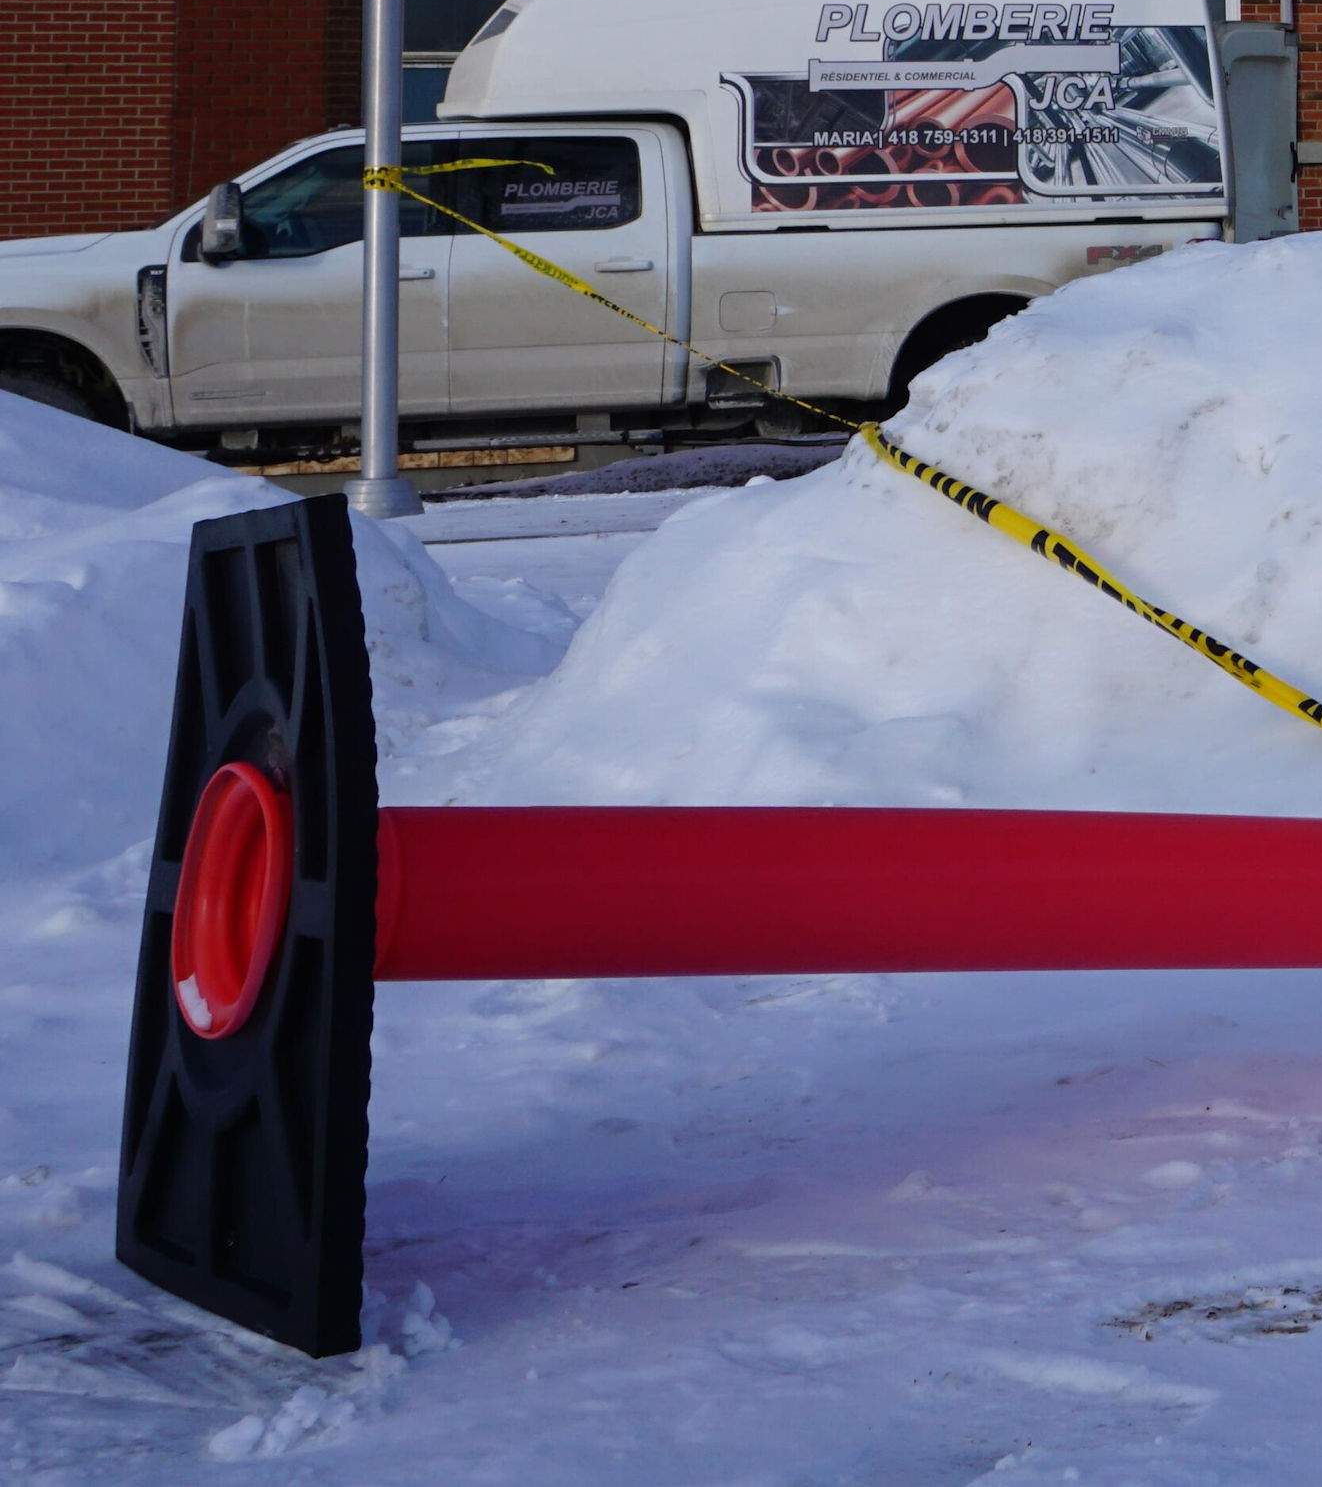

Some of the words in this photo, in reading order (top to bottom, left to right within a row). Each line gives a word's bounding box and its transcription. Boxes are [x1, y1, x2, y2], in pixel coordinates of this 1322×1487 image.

[815, 2, 1115, 44] PLOMBERIE
[820, 70, 891, 82] RÉSIDENTIEL
[894, 73, 901, 81] &
[904, 71, 977, 81] COMMERCIAL
[1029, 75, 1117, 111] JCA
[813, 130, 874, 147] MARIA
[887, 130, 919, 146] 418
[923, 129, 998, 145] 759-1311
[1012, 127, 1044, 144] 418
[1046, 126, 1120, 144] 391-1511
[504, 180, 618, 197] PLOMBERIE
[585, 205, 618, 219] JCA
